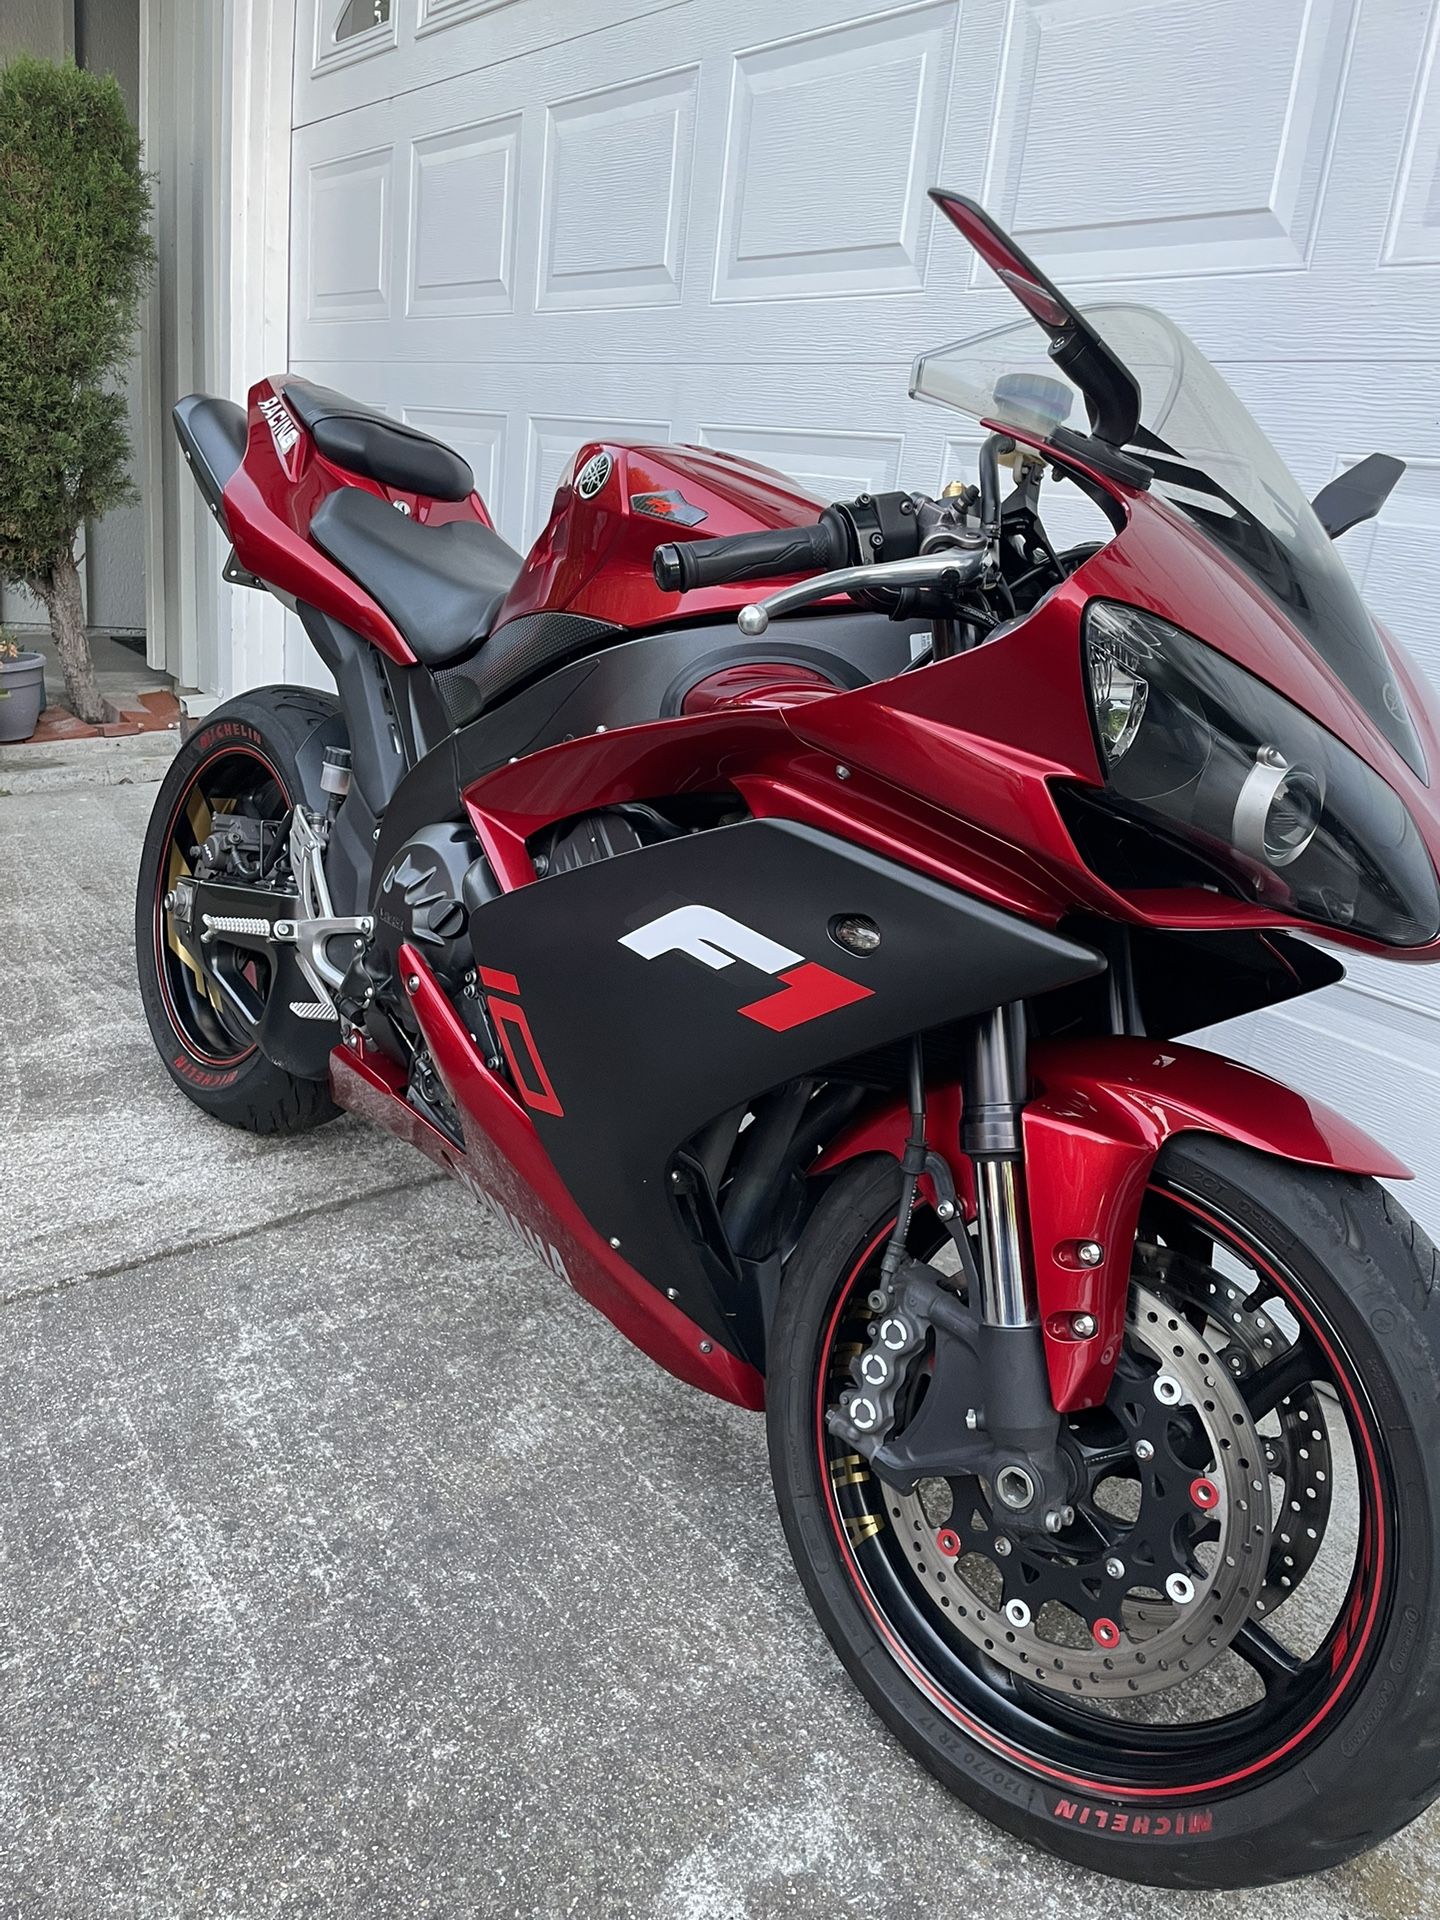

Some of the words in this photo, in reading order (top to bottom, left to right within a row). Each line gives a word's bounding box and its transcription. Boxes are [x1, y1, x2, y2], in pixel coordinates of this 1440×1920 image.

[257, 396, 300, 450] RACING
[199, 722, 262, 749] MICHELIN
[174, 1055, 239, 1087] MICHELIN
[963, 1751, 1023, 1797] 120/70
[1053, 1799, 1214, 1836] MICHELIN
